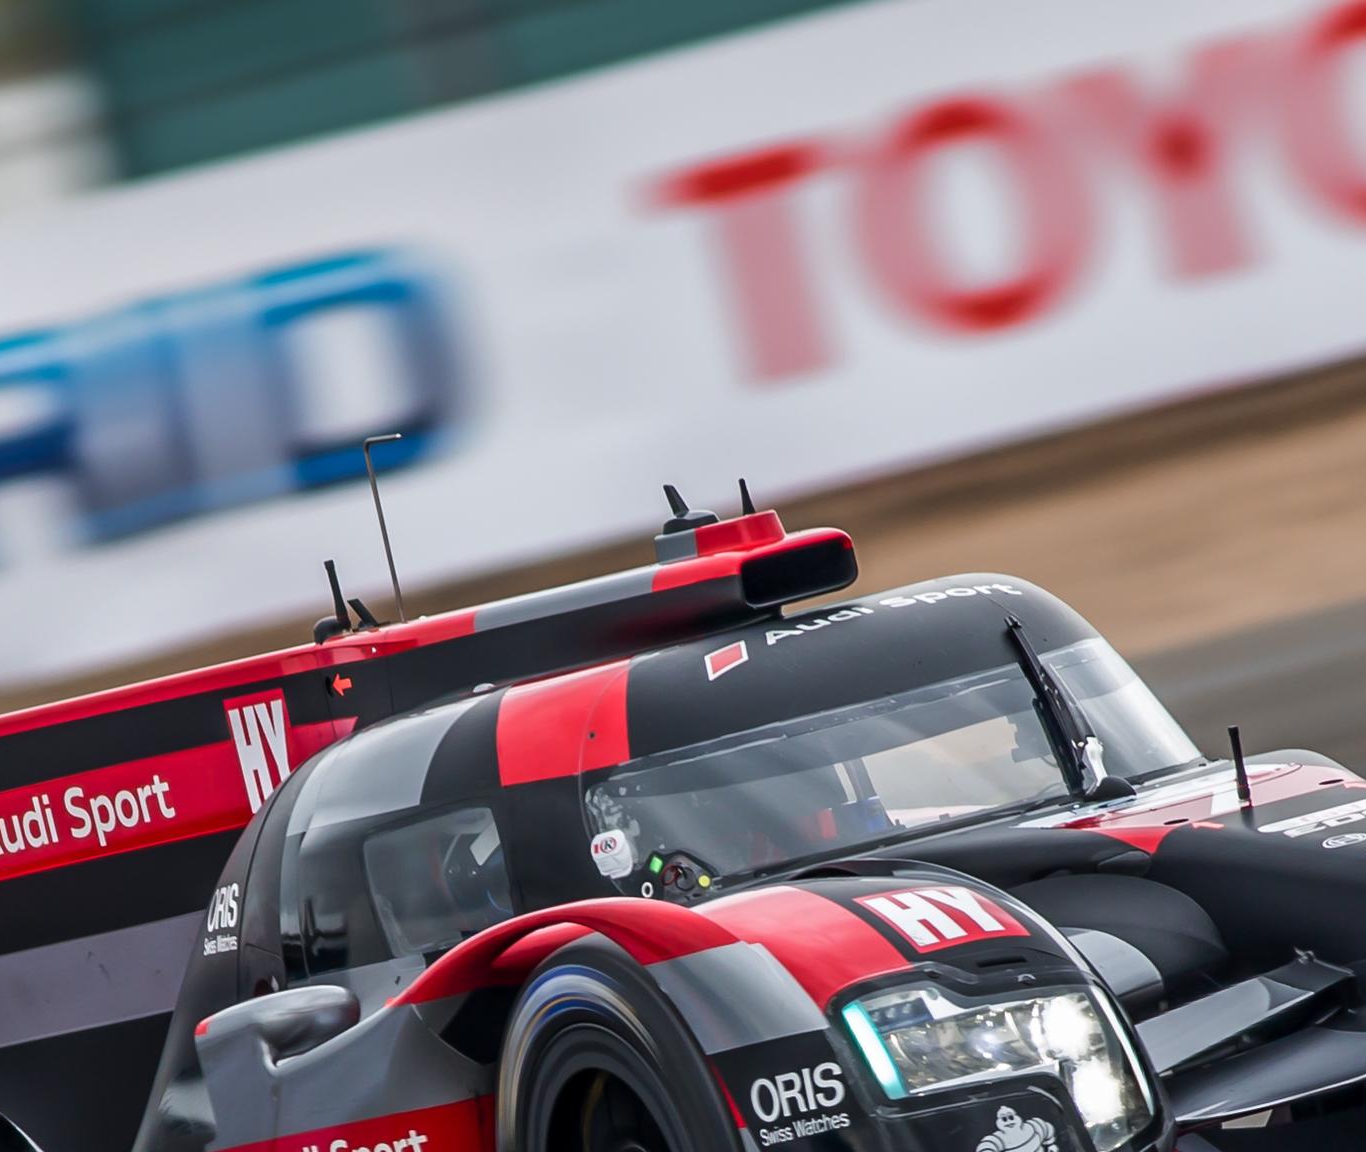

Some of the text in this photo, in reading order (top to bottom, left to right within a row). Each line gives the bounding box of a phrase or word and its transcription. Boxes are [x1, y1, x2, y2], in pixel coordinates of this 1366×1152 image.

[765, 583, 1023, 645] Audi Sport
[228, 699, 291, 814] HY
[64, 774, 176, 846] Sport
[860, 886, 1006, 947] HY
[751, 1062, 845, 1123] ORIS
[759, 1113, 851, 1147] Swiss Watches
